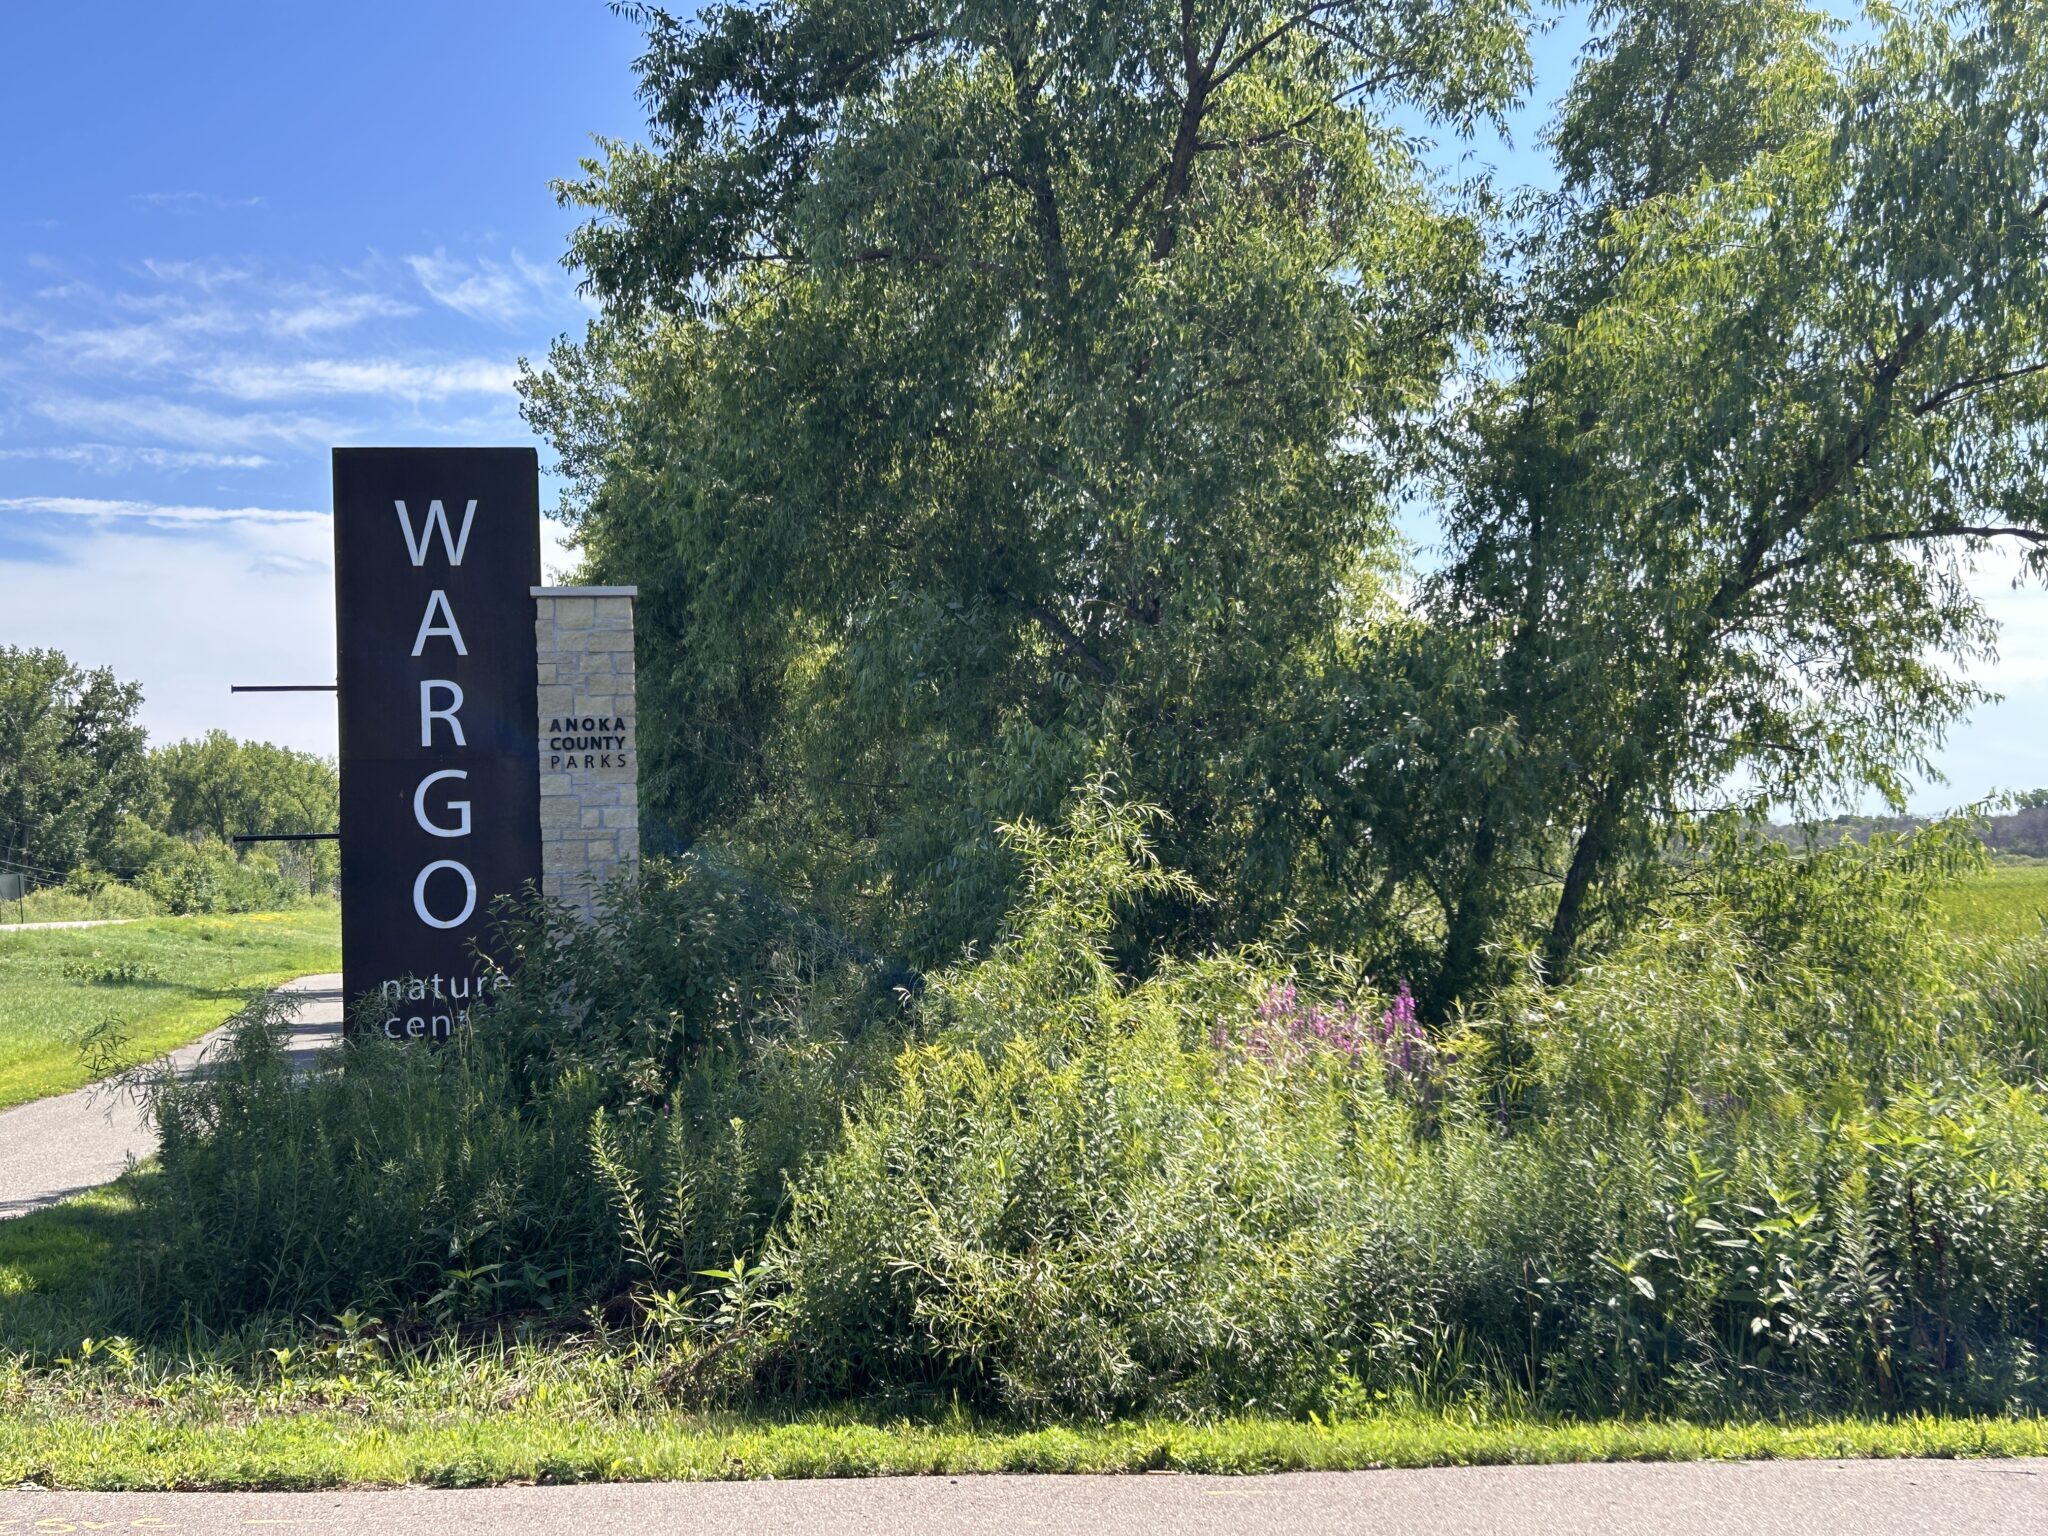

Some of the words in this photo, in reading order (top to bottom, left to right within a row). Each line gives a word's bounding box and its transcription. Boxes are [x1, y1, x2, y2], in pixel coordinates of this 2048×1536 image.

[394, 499, 478, 930] WARGO
[549, 717, 626, 733] ANOKA
[550, 736, 626, 751] COUNTY
[551, 753, 627, 769] PARKS
[382, 973, 514, 1001] nature
